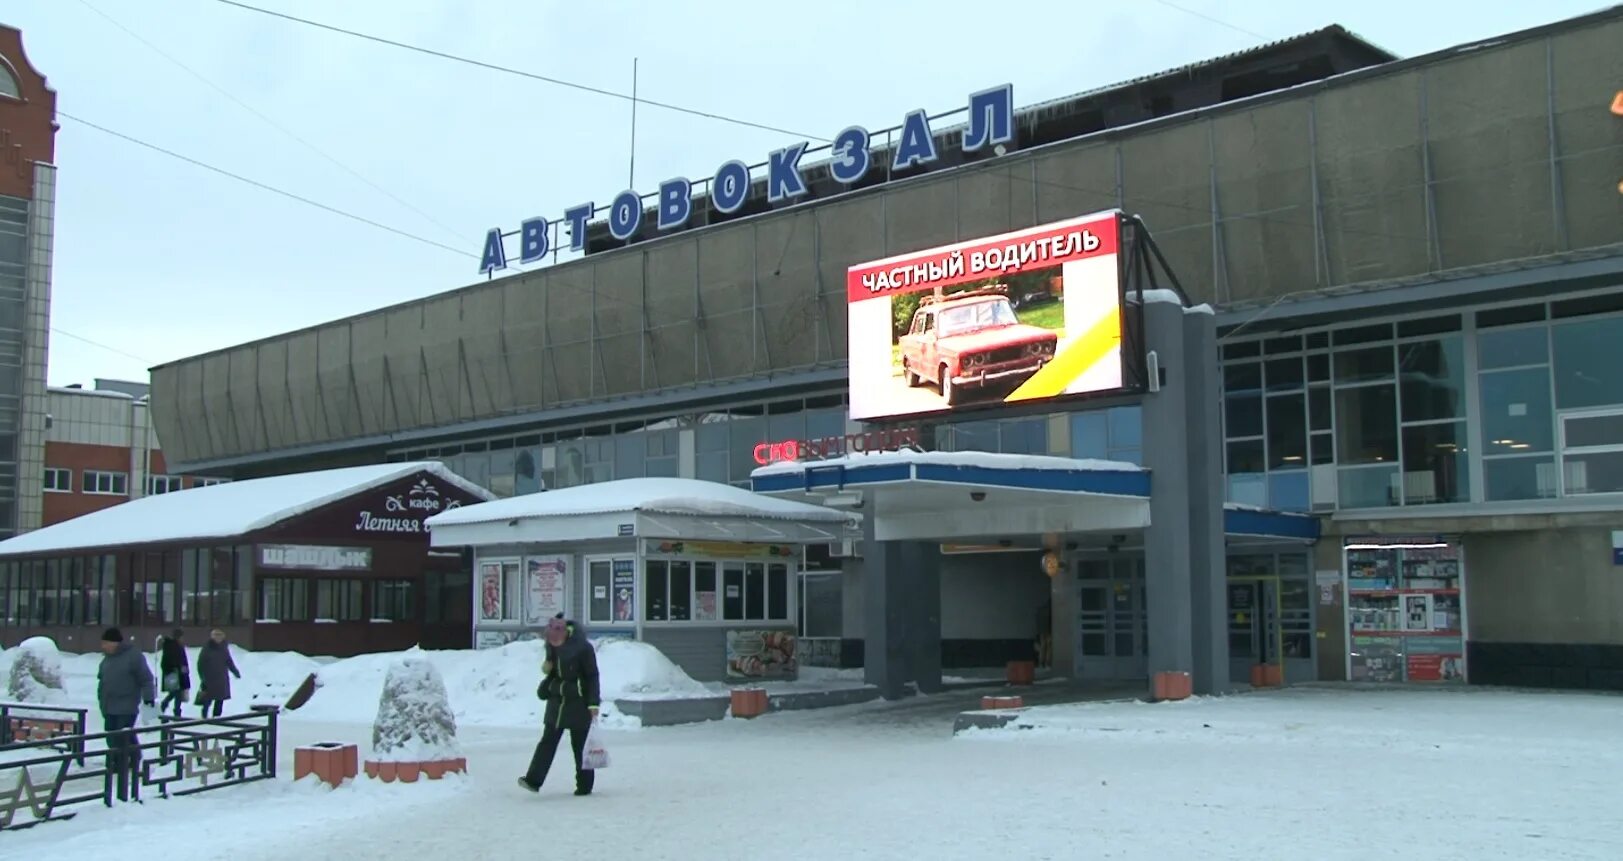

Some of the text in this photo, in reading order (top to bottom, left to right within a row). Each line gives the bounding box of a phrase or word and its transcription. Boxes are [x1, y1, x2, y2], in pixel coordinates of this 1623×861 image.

[478, 83, 1013, 274] АВТОВОКЗАЛ
[862, 230, 1100, 292] ЧАСТНЫЙ ВОДИТЕЛЬ
[355, 511, 420, 533] Летняя
[409, 497, 440, 511] кафе
